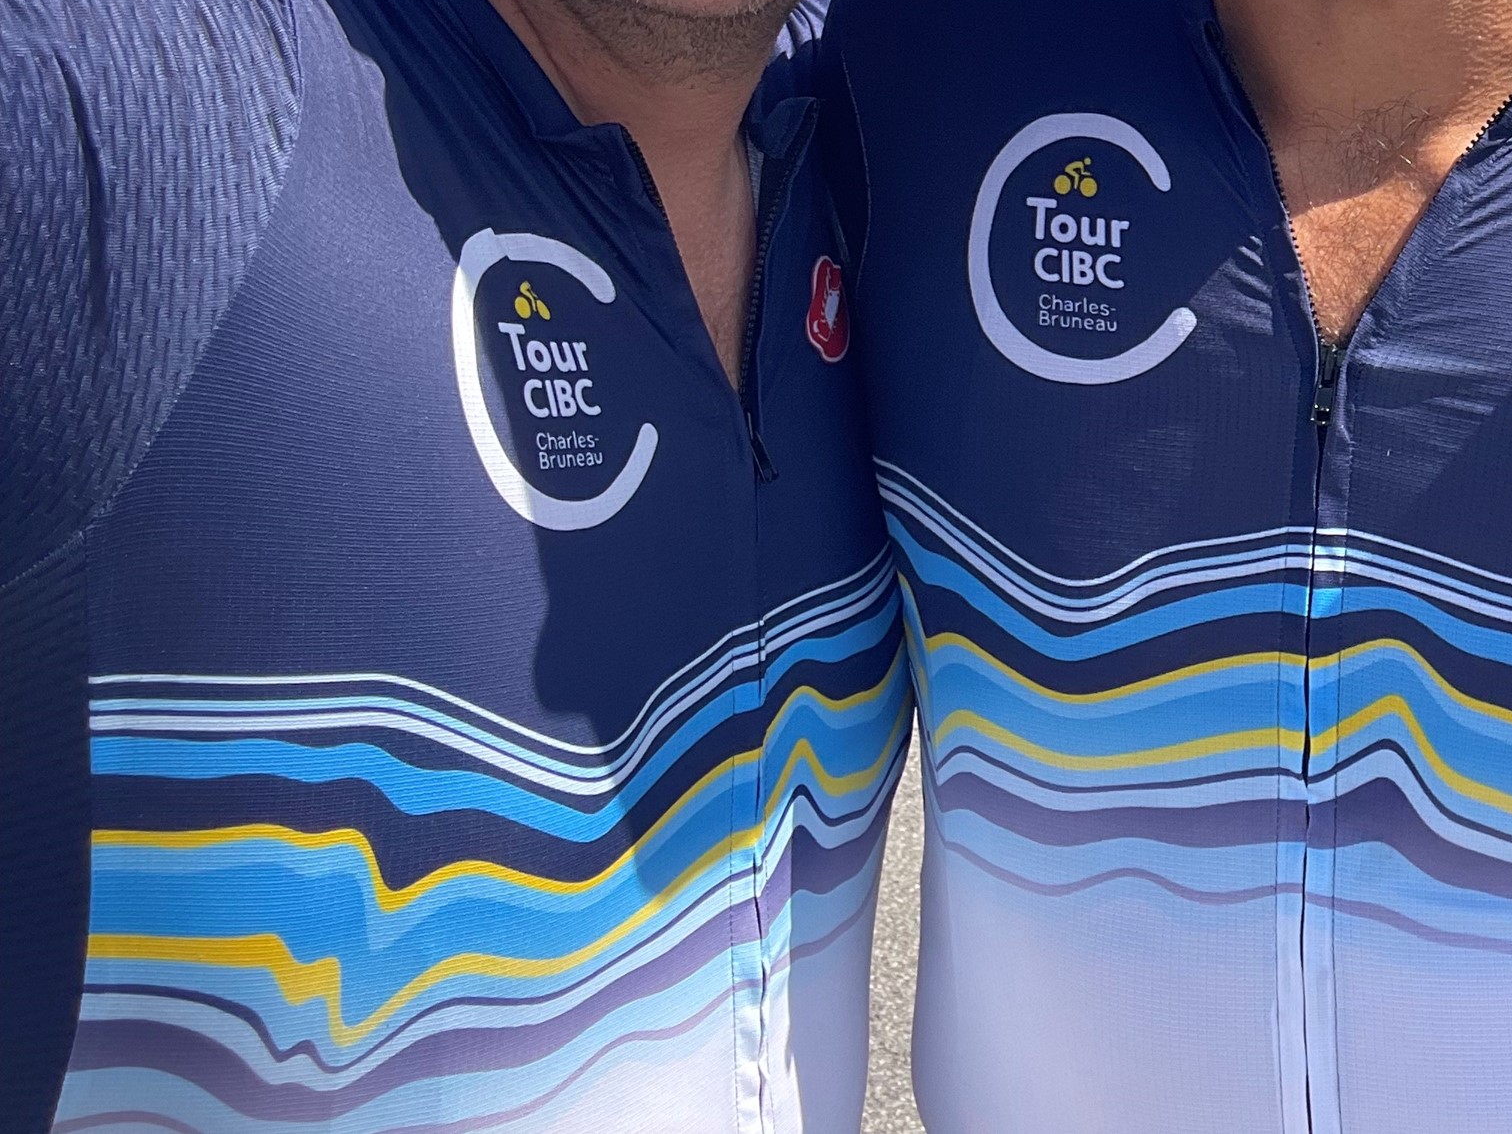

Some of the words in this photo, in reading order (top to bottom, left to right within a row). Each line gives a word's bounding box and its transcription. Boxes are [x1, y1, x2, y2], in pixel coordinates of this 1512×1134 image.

[1025, 196, 1130, 248] Tour
[1033, 247, 1125, 290] CIBC
[1038, 294, 1117, 316] Charles-
[1039, 310, 1118, 332] Bruneau
[498, 322, 589, 372] Tour
[523, 378, 602, 418] CIBC
[536, 430, 600, 451] Charles-
[538, 450, 604, 470] Bruneau
